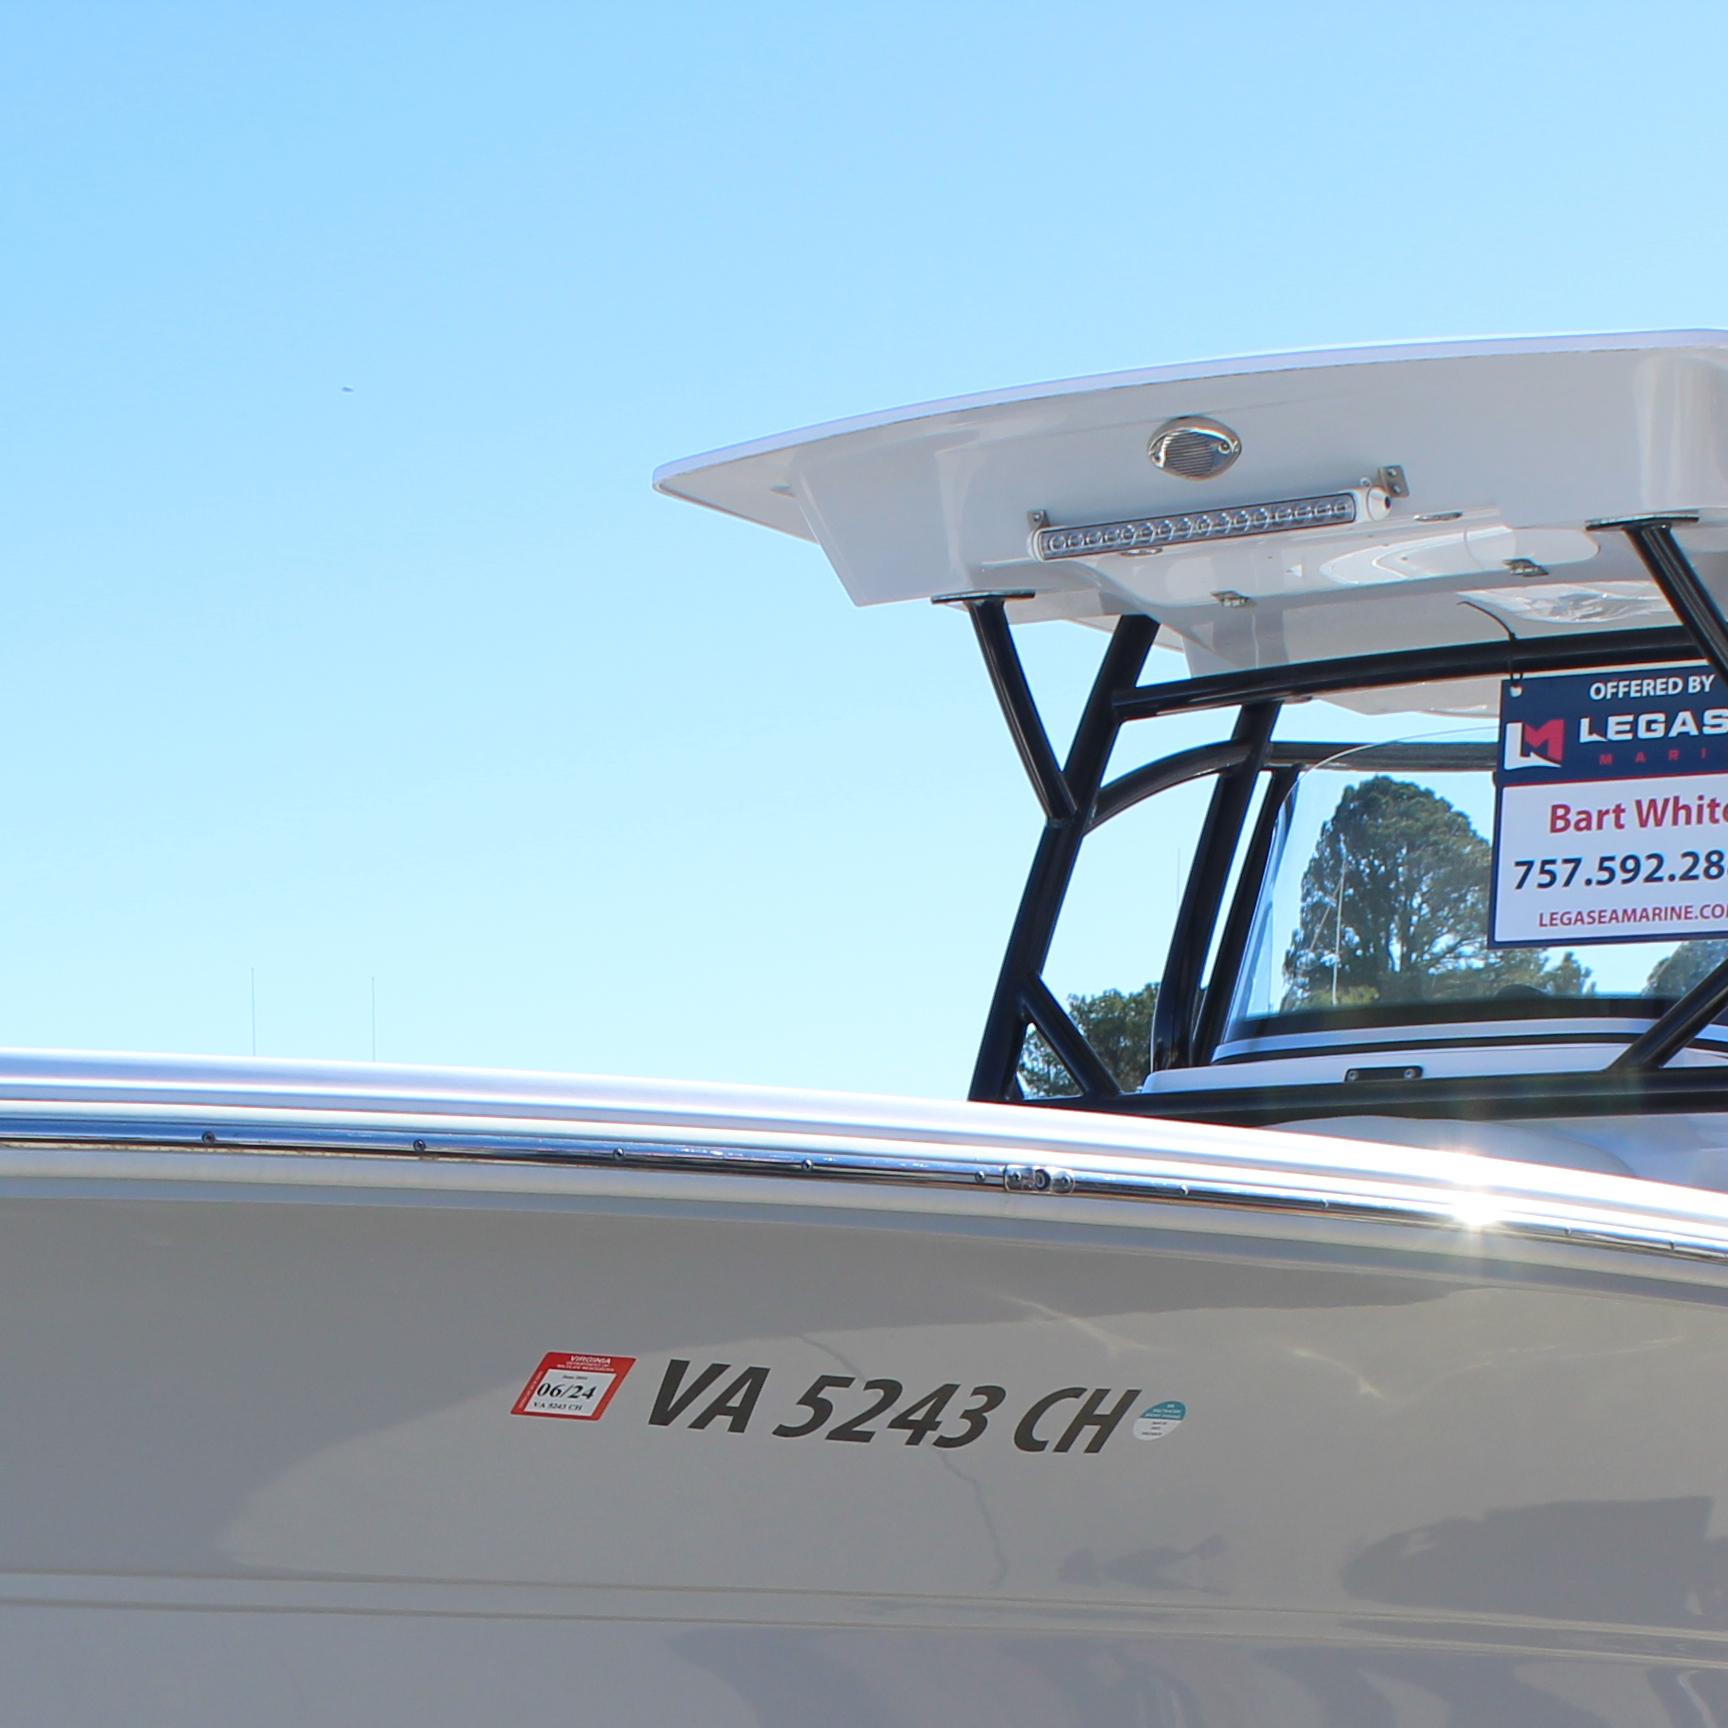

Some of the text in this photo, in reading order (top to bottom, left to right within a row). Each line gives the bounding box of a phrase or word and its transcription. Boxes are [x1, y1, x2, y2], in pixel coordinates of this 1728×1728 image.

[1589, 674, 1716, 701] OFFERED BY
[1549, 802, 1626, 834] Bart
[536, 1382, 598, 1400] 06/24
[646, 1358, 1142, 1454] VA 5243 CH
